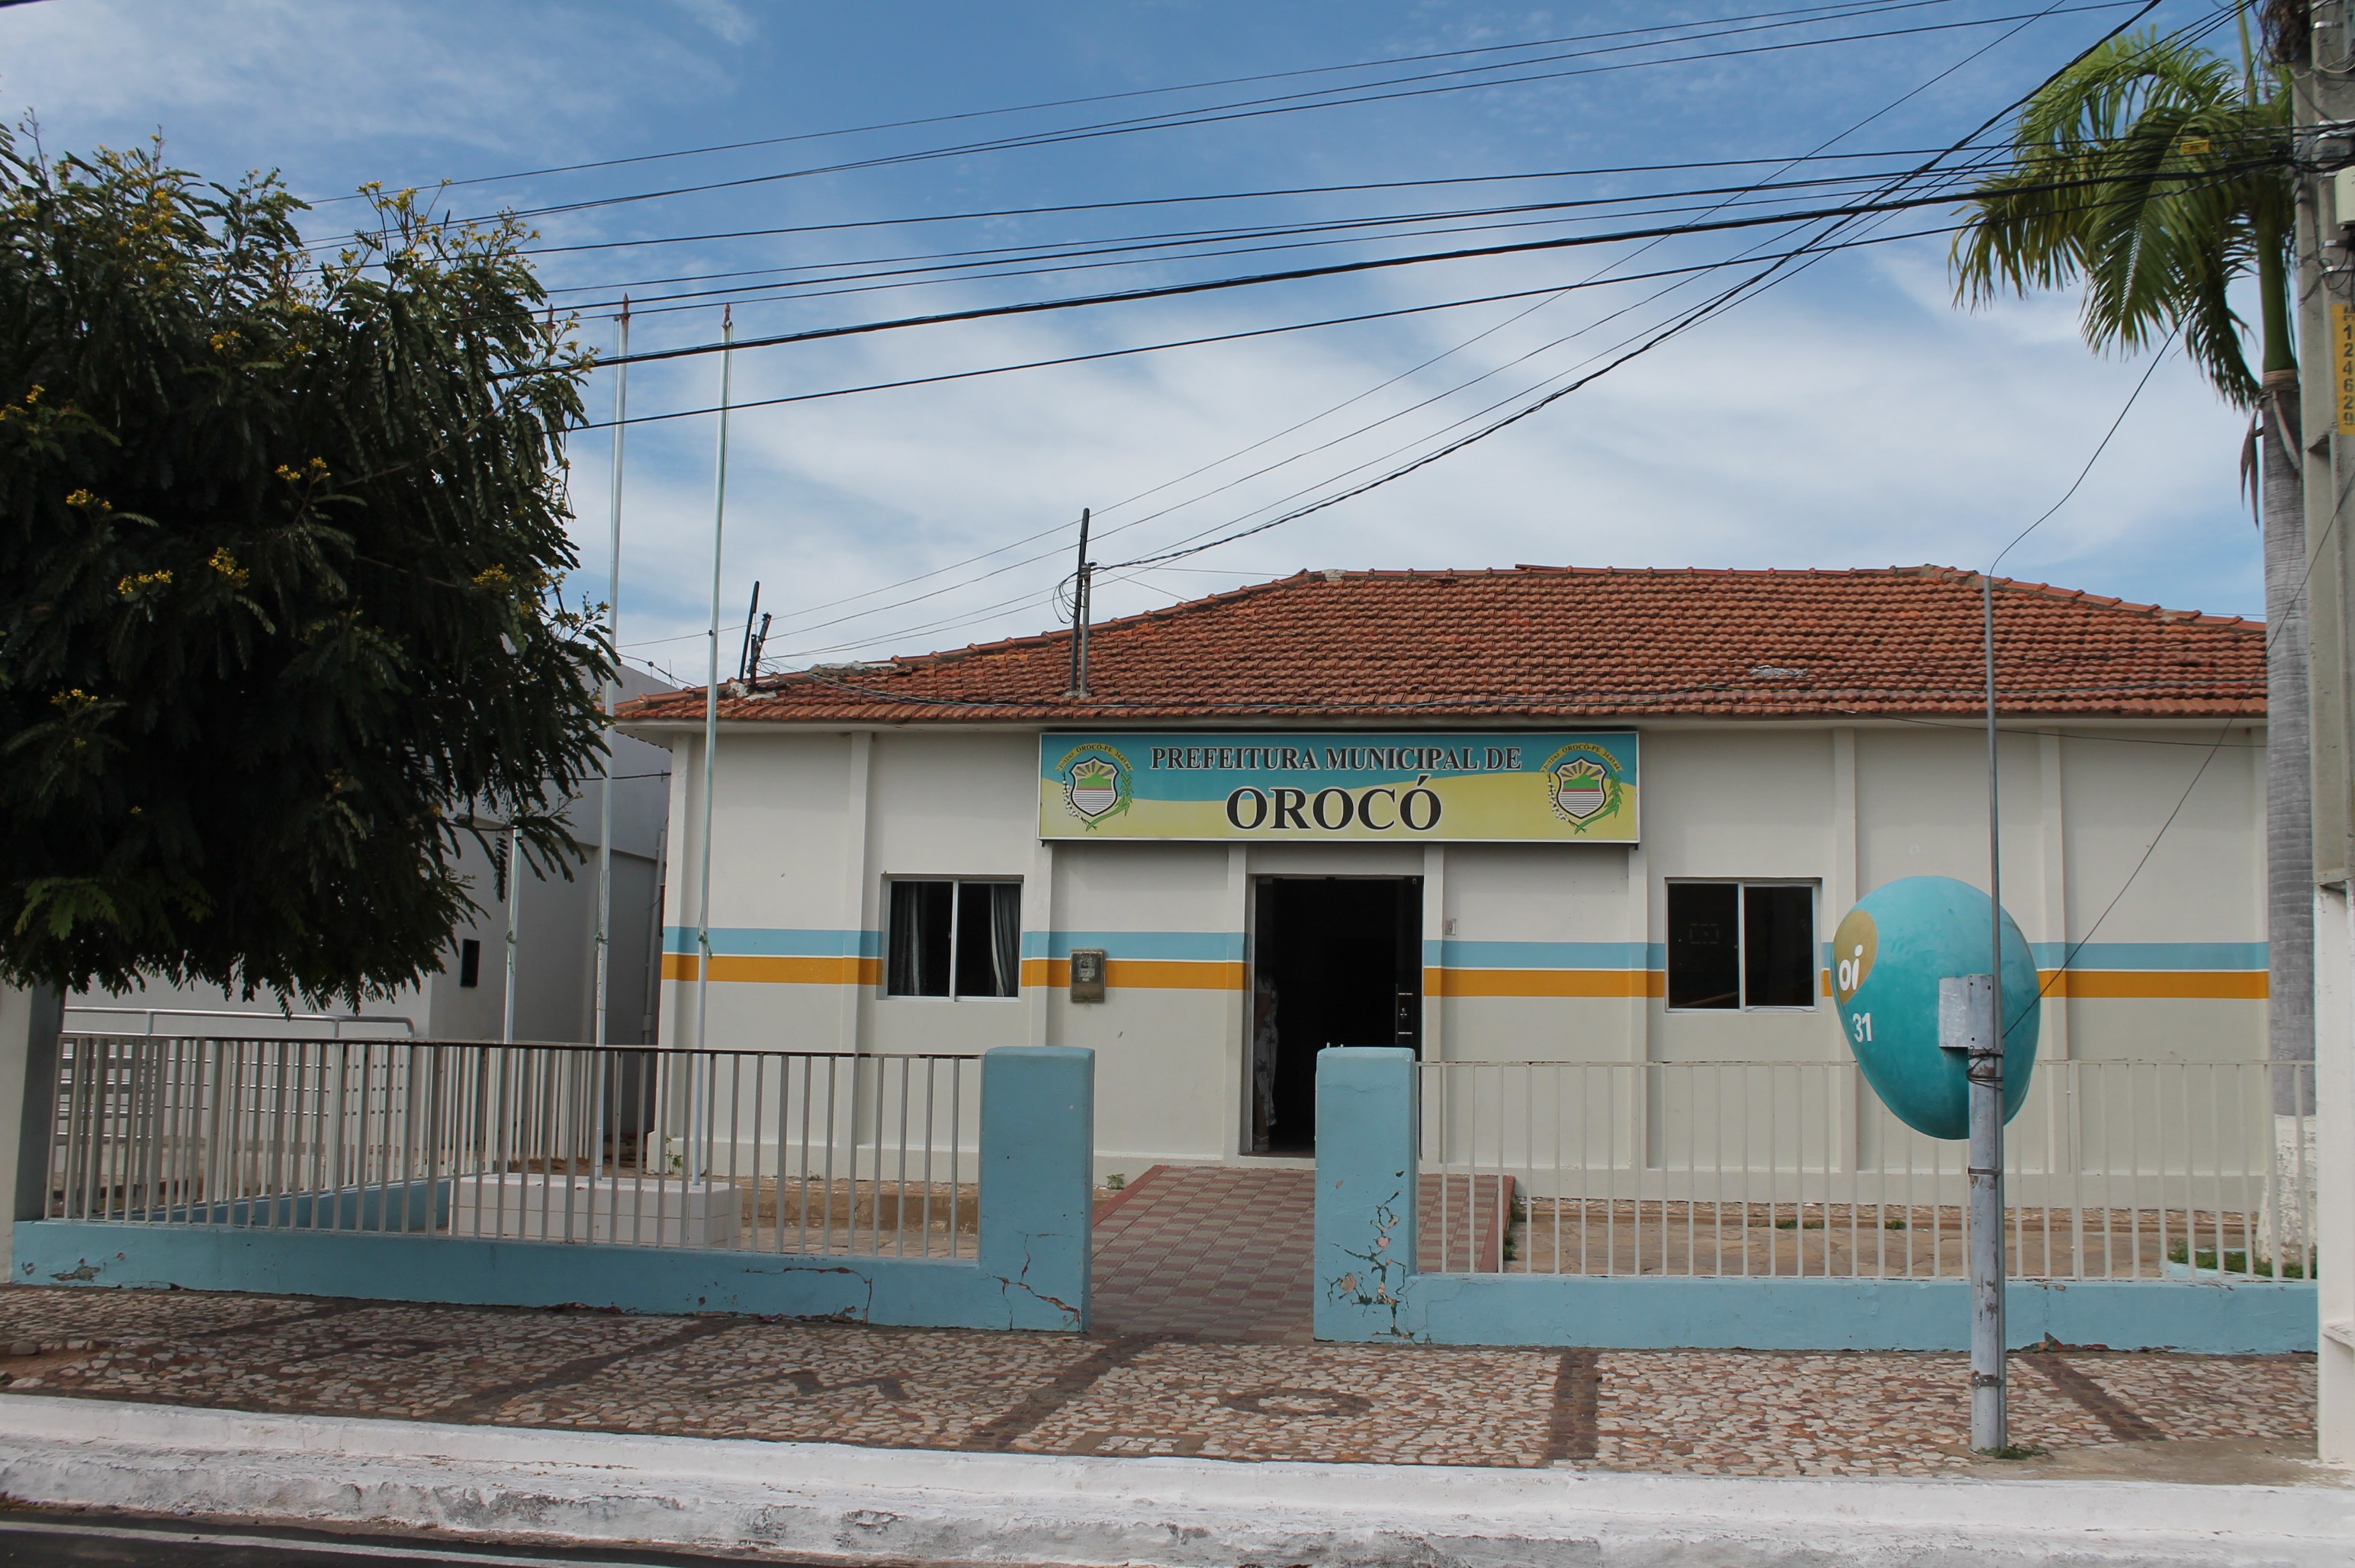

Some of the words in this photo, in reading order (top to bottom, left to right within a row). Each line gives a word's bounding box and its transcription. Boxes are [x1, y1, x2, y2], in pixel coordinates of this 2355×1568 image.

[1076, 743, 1113, 753] OROCÓ-PE
[1150, 747, 1320, 770] PREFEITURA
[1325, 747, 1480, 770] MUNICIPAL
[1484, 747, 1521, 770] DE
[1561, 743, 1601, 753] OROCÓ-PE
[1226, 774, 1442, 831] OROCÓ
[1852, 1012, 1872, 1043] 31
